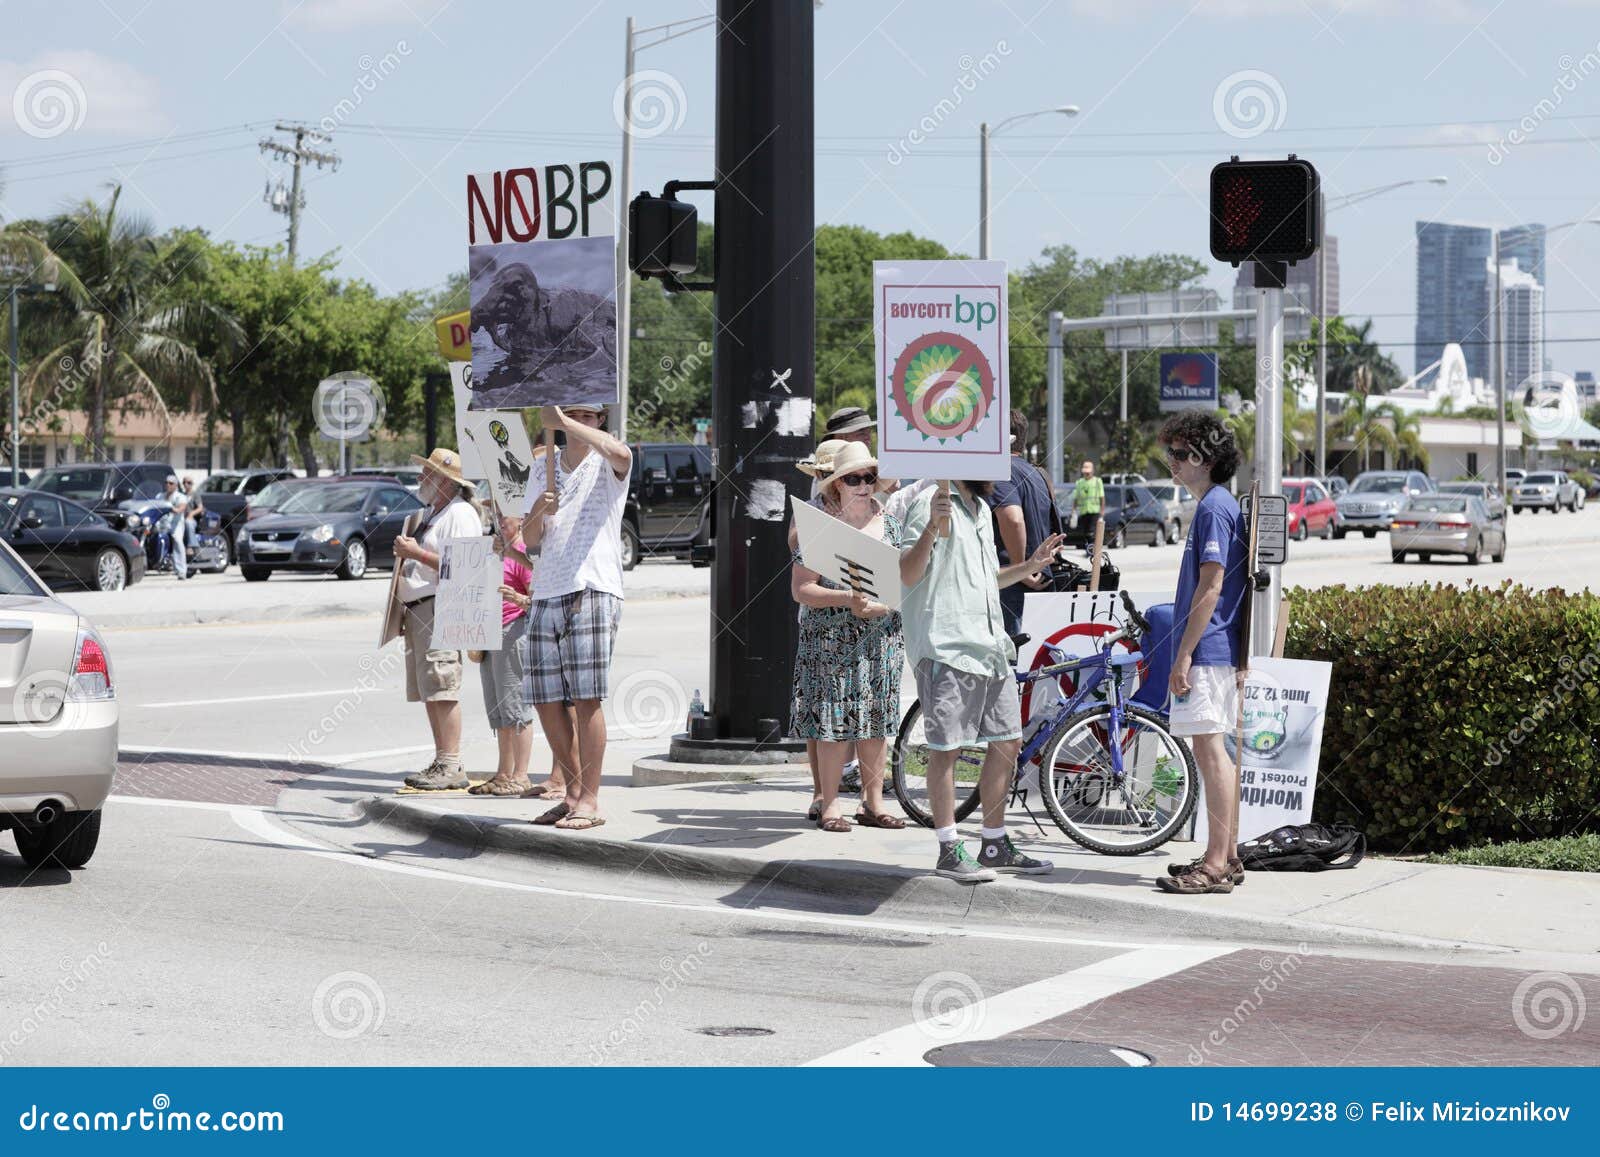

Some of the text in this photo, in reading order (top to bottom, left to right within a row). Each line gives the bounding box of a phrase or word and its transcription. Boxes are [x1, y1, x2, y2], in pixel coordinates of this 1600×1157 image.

[467, 161, 612, 245] NO BP
[890, 294, 997, 331] BOYCOTT bp
[1281, 688, 1311, 704] June
[1261, 772, 1308, 787] Protest
